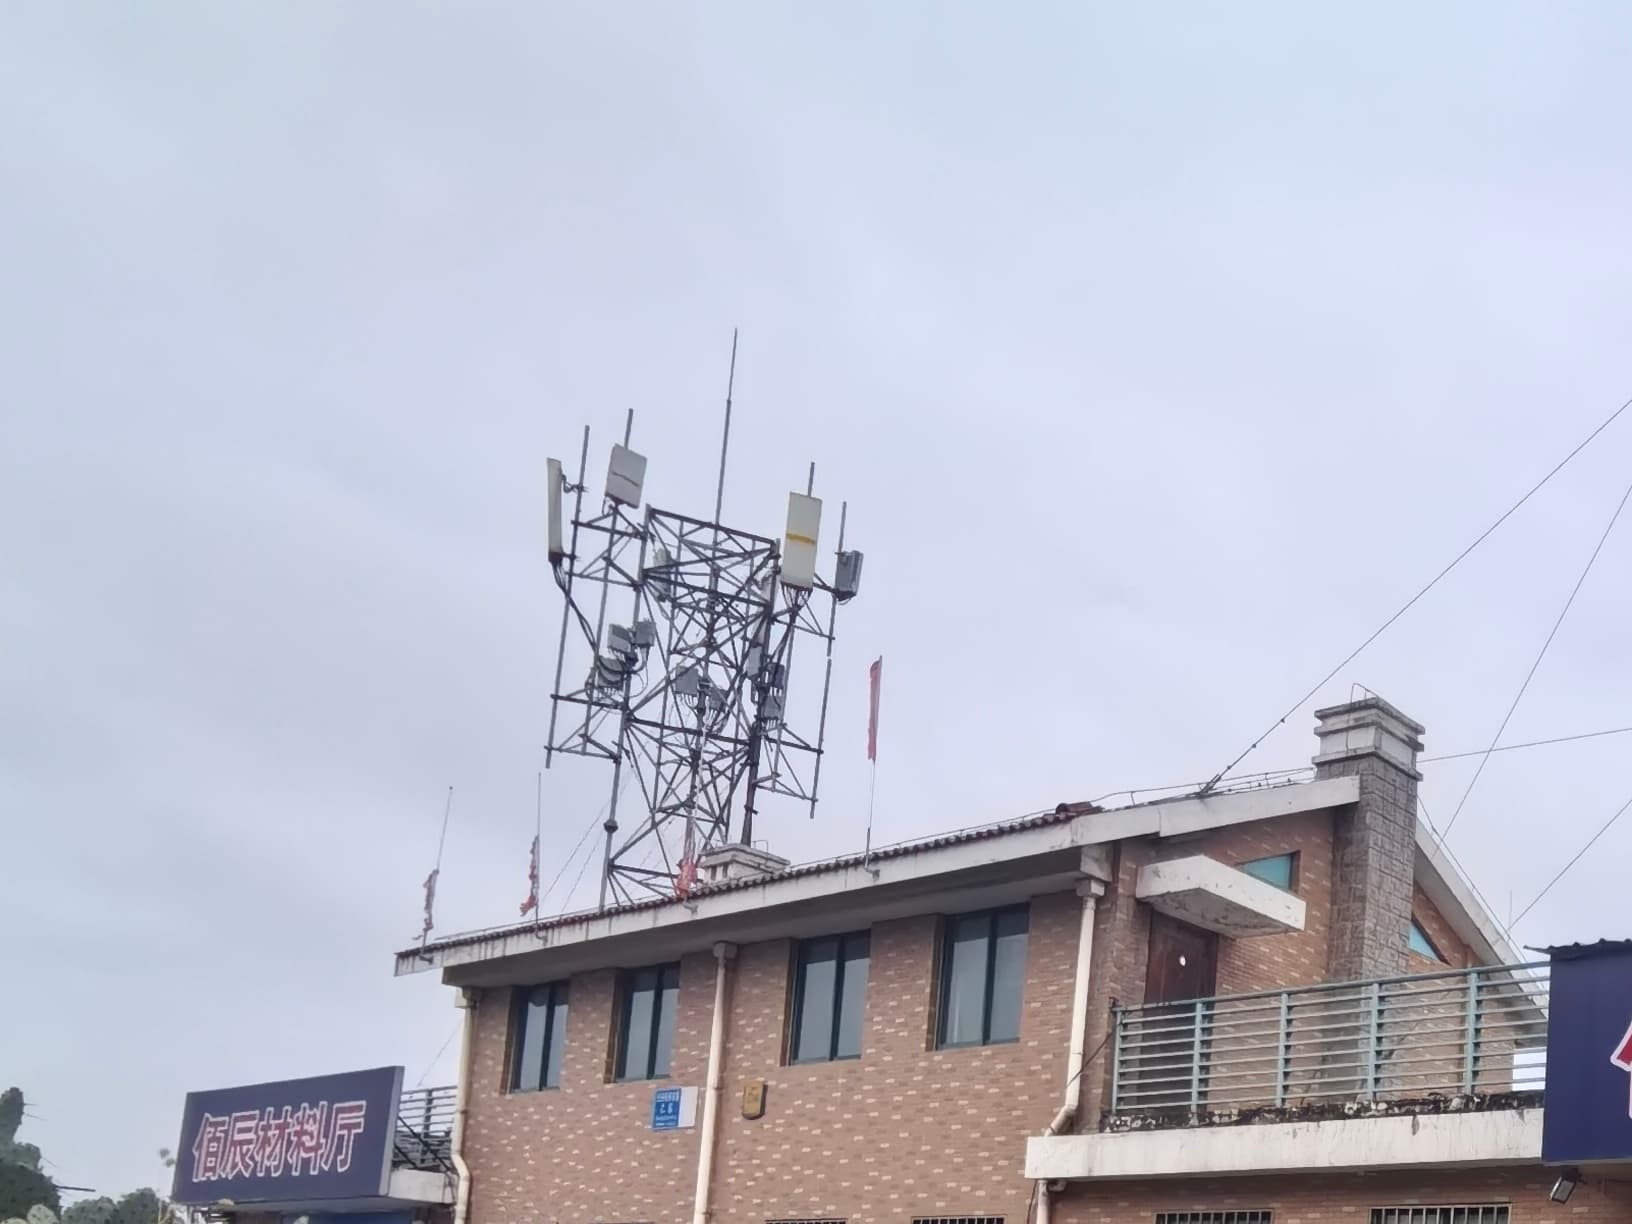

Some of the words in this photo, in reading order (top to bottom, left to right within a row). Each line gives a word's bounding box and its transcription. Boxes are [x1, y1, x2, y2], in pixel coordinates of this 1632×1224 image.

[191, 1100, 367, 1183] 佰辰材料厅
